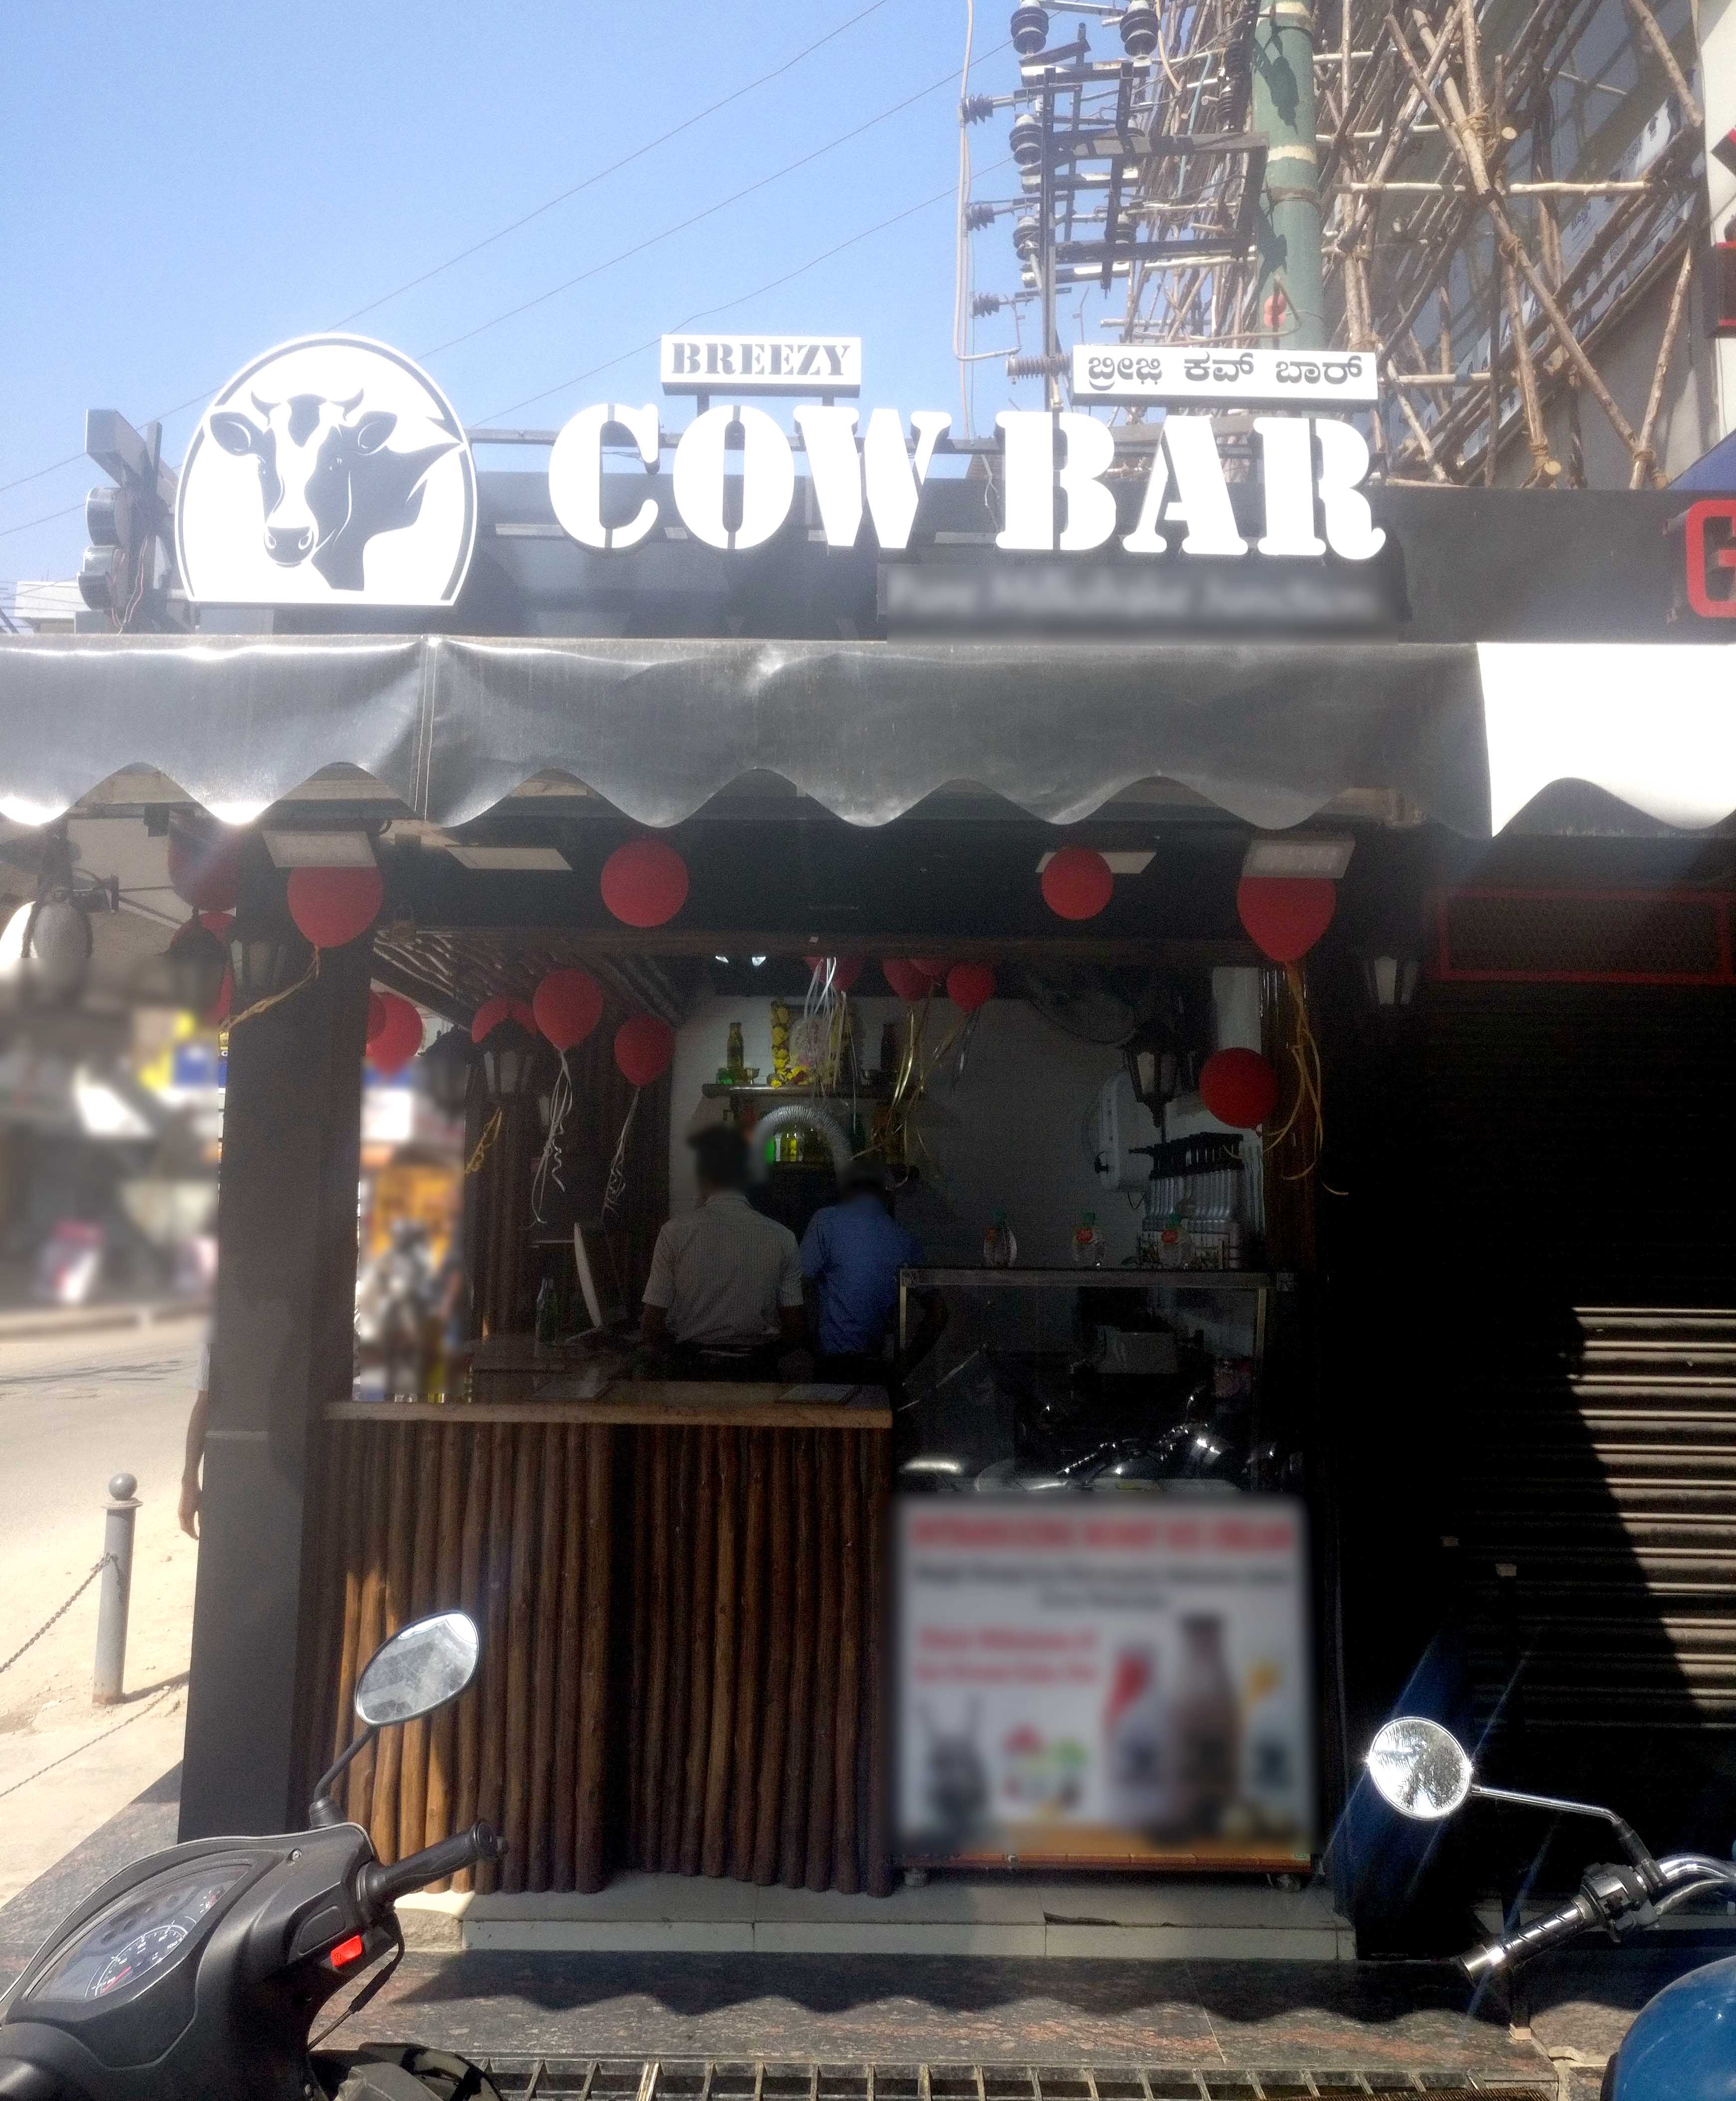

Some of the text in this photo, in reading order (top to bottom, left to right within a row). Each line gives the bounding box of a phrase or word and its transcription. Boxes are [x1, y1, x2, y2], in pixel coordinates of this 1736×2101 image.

[671, 343, 851, 376] BREEZY
[1184, 351, 1254, 382] ಕವ್
[1275, 355, 1363, 385] ಬಾರ್
[549, 404, 1387, 560] COW BAR
